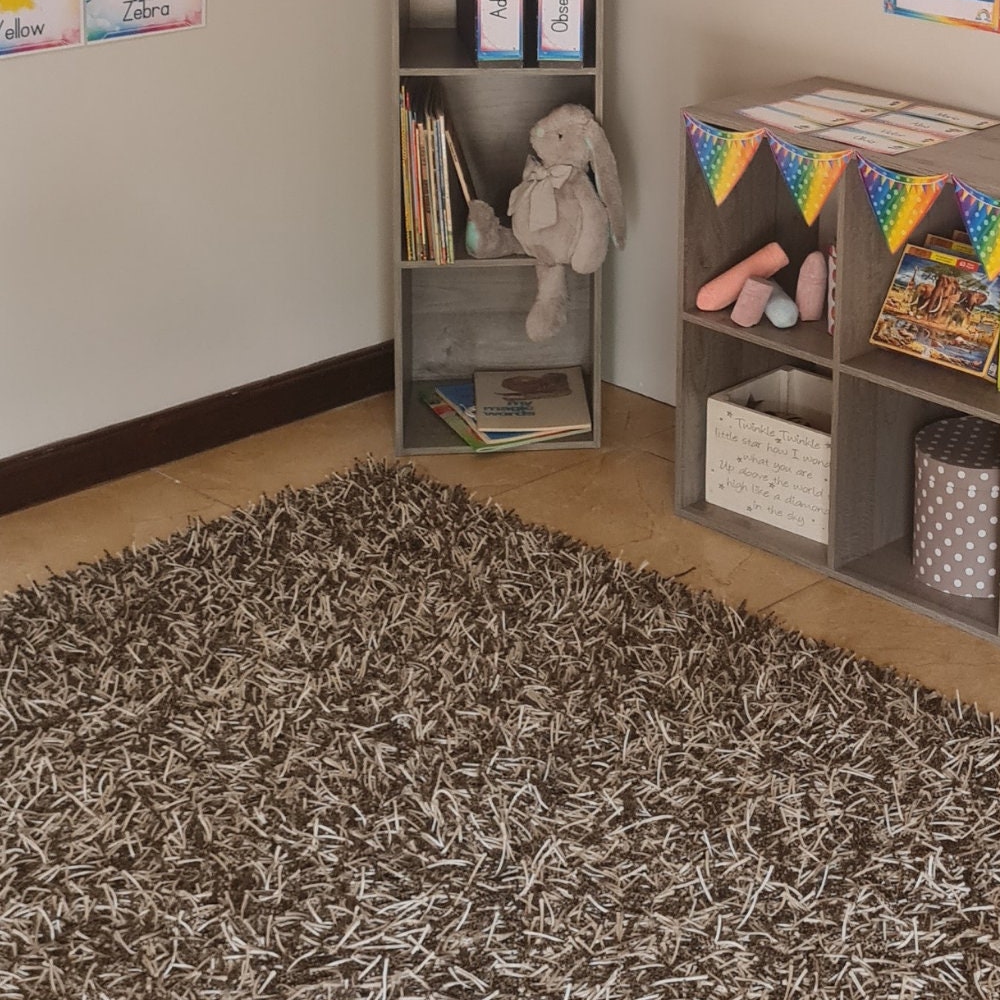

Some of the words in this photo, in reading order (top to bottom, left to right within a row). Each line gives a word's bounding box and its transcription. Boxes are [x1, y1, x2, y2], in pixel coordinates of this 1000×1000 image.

[122, 0, 170, 22] Zebra
[735, 418, 775, 437] Twinkle
[779, 430, 821, 449] Twinkle
